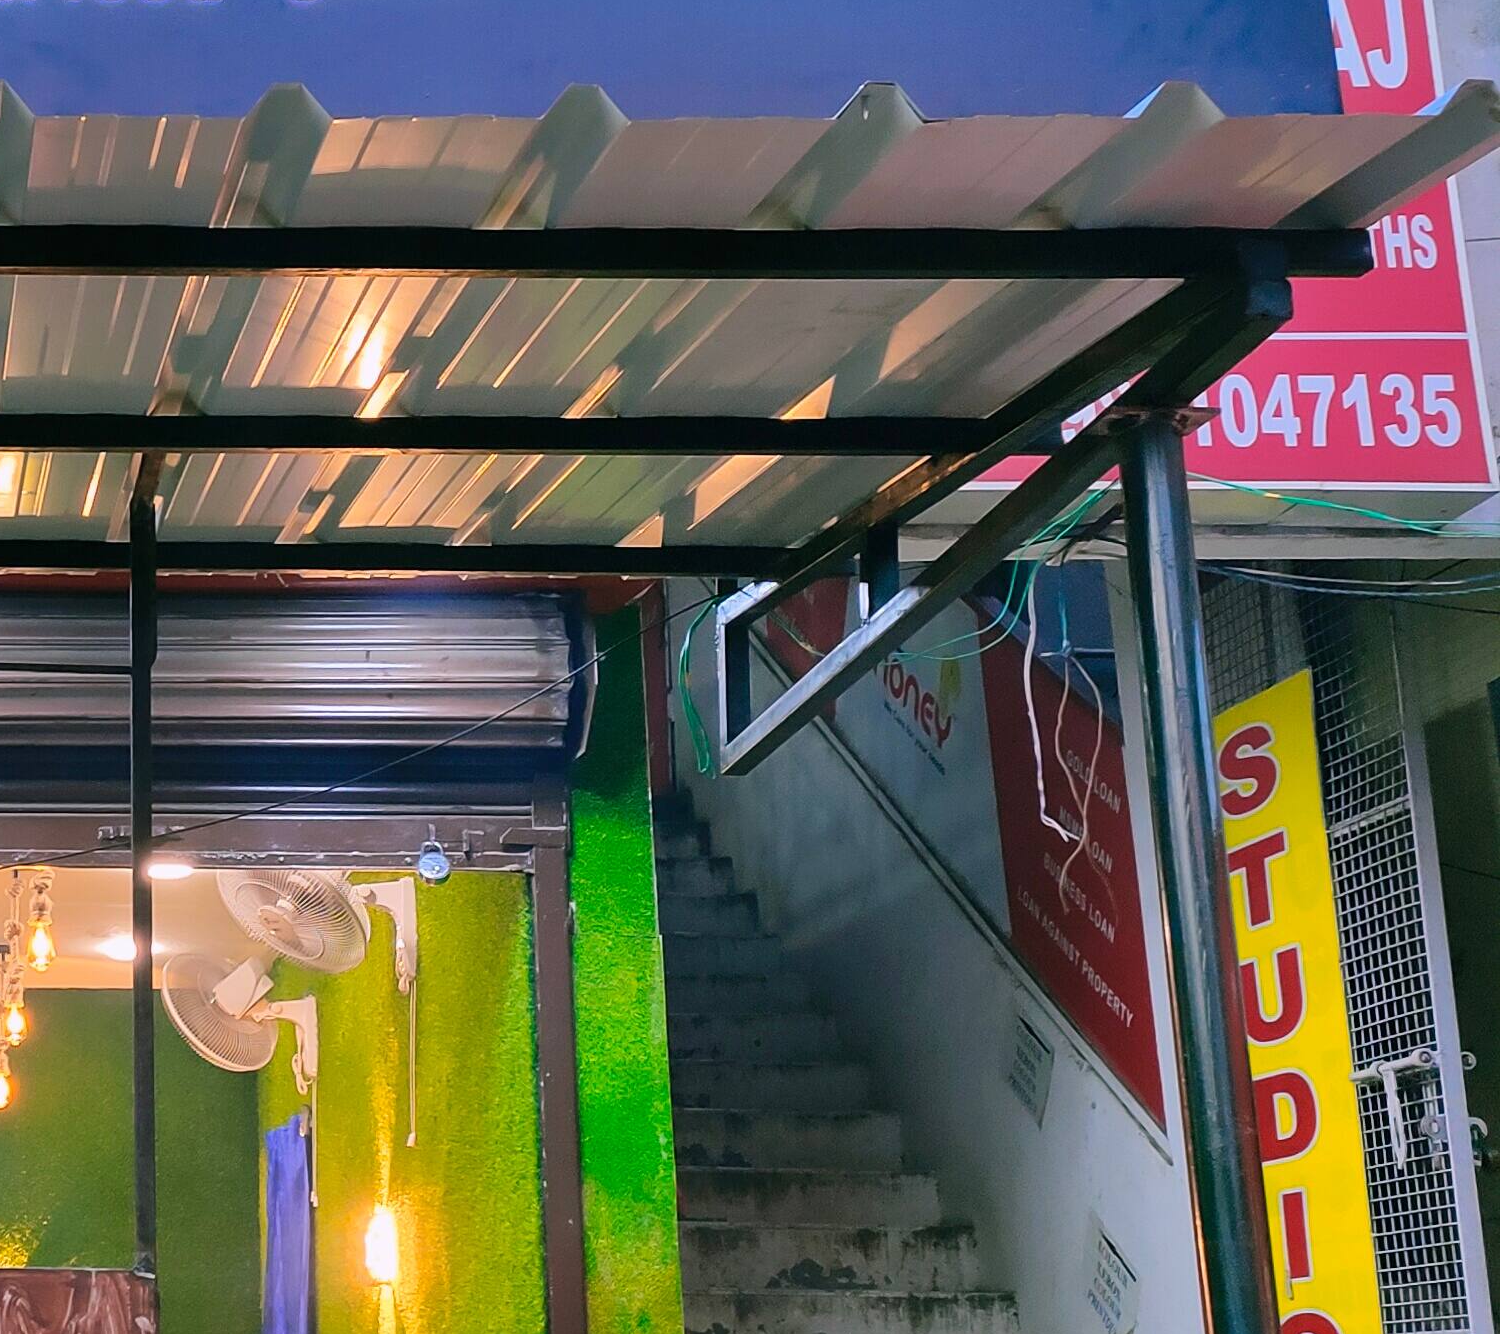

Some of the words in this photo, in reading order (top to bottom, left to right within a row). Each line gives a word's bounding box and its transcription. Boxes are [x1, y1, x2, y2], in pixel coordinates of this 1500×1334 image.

[1093, 781, 1122, 815] LOAN
[1088, 840, 1114, 874] OAN
[1043, 852, 1088, 911] BUSNESS
[1088, 901, 1116, 945] LOAN
[1081, 959, 1135, 1029] PROPERTY
